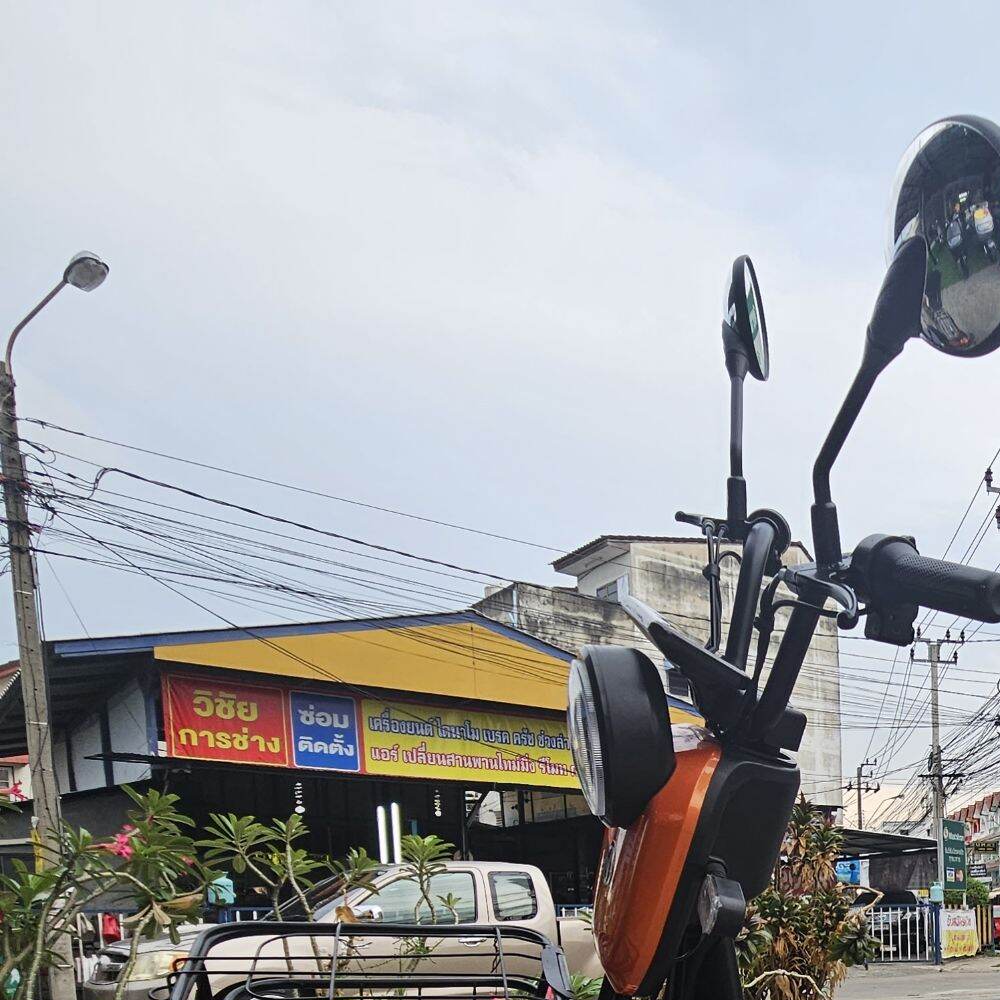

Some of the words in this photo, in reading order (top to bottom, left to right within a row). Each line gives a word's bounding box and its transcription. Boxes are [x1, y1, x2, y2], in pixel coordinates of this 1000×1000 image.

[193, 689, 260, 722] วิชัย
[298, 704, 350, 729] ซ่อม
[178, 727, 281, 754] การช่าง
[368, 707, 434, 738] เครื่องยนต์
[537, 727, 574, 751] ช่วงล่า
[298, 734, 355, 757] ติดตั้ง
[370, 744, 400, 762] แอร์
